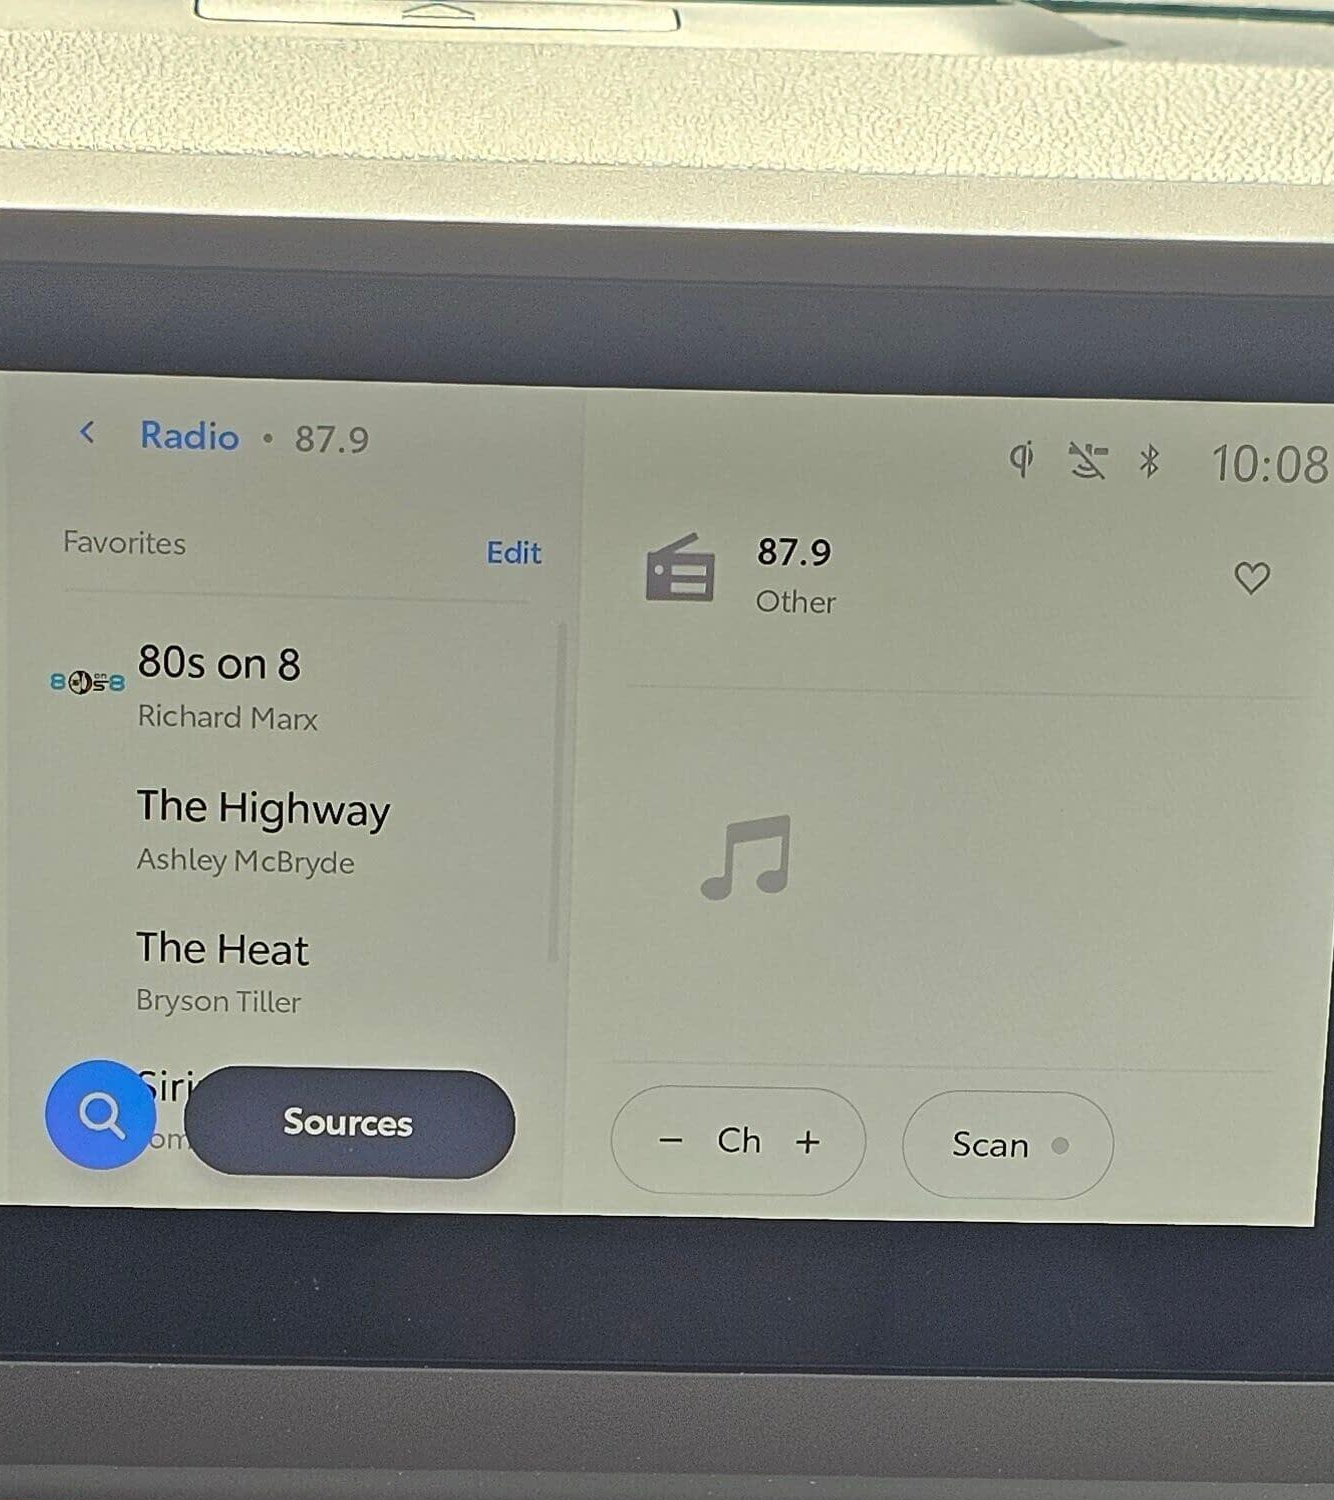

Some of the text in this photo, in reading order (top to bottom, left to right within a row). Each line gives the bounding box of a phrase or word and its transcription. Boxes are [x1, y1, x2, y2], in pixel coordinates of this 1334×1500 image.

[142, 420, 368, 453] Radio 87.9
[1214, 444, 1328, 484] 10:08
[65, 530, 186, 555] Favorites
[488, 540, 542, 564] Edit
[758, 538, 830, 566] 87.9
[757, 589, 836, 613] Other
[139, 644, 300, 681] 80s on 8
[139, 704, 317, 731] Richard Marx
[137, 788, 390, 834] The Highway
[137, 847, 354, 880] Ashley McBryde
[136, 930, 309, 966] The Heat
[138, 988, 301, 1017] Bryson Tiller
[284, 1107, 413, 1137] Sources
[719, 1126, 760, 1153] Ch
[953, 1131, 1028, 1157] Scan
